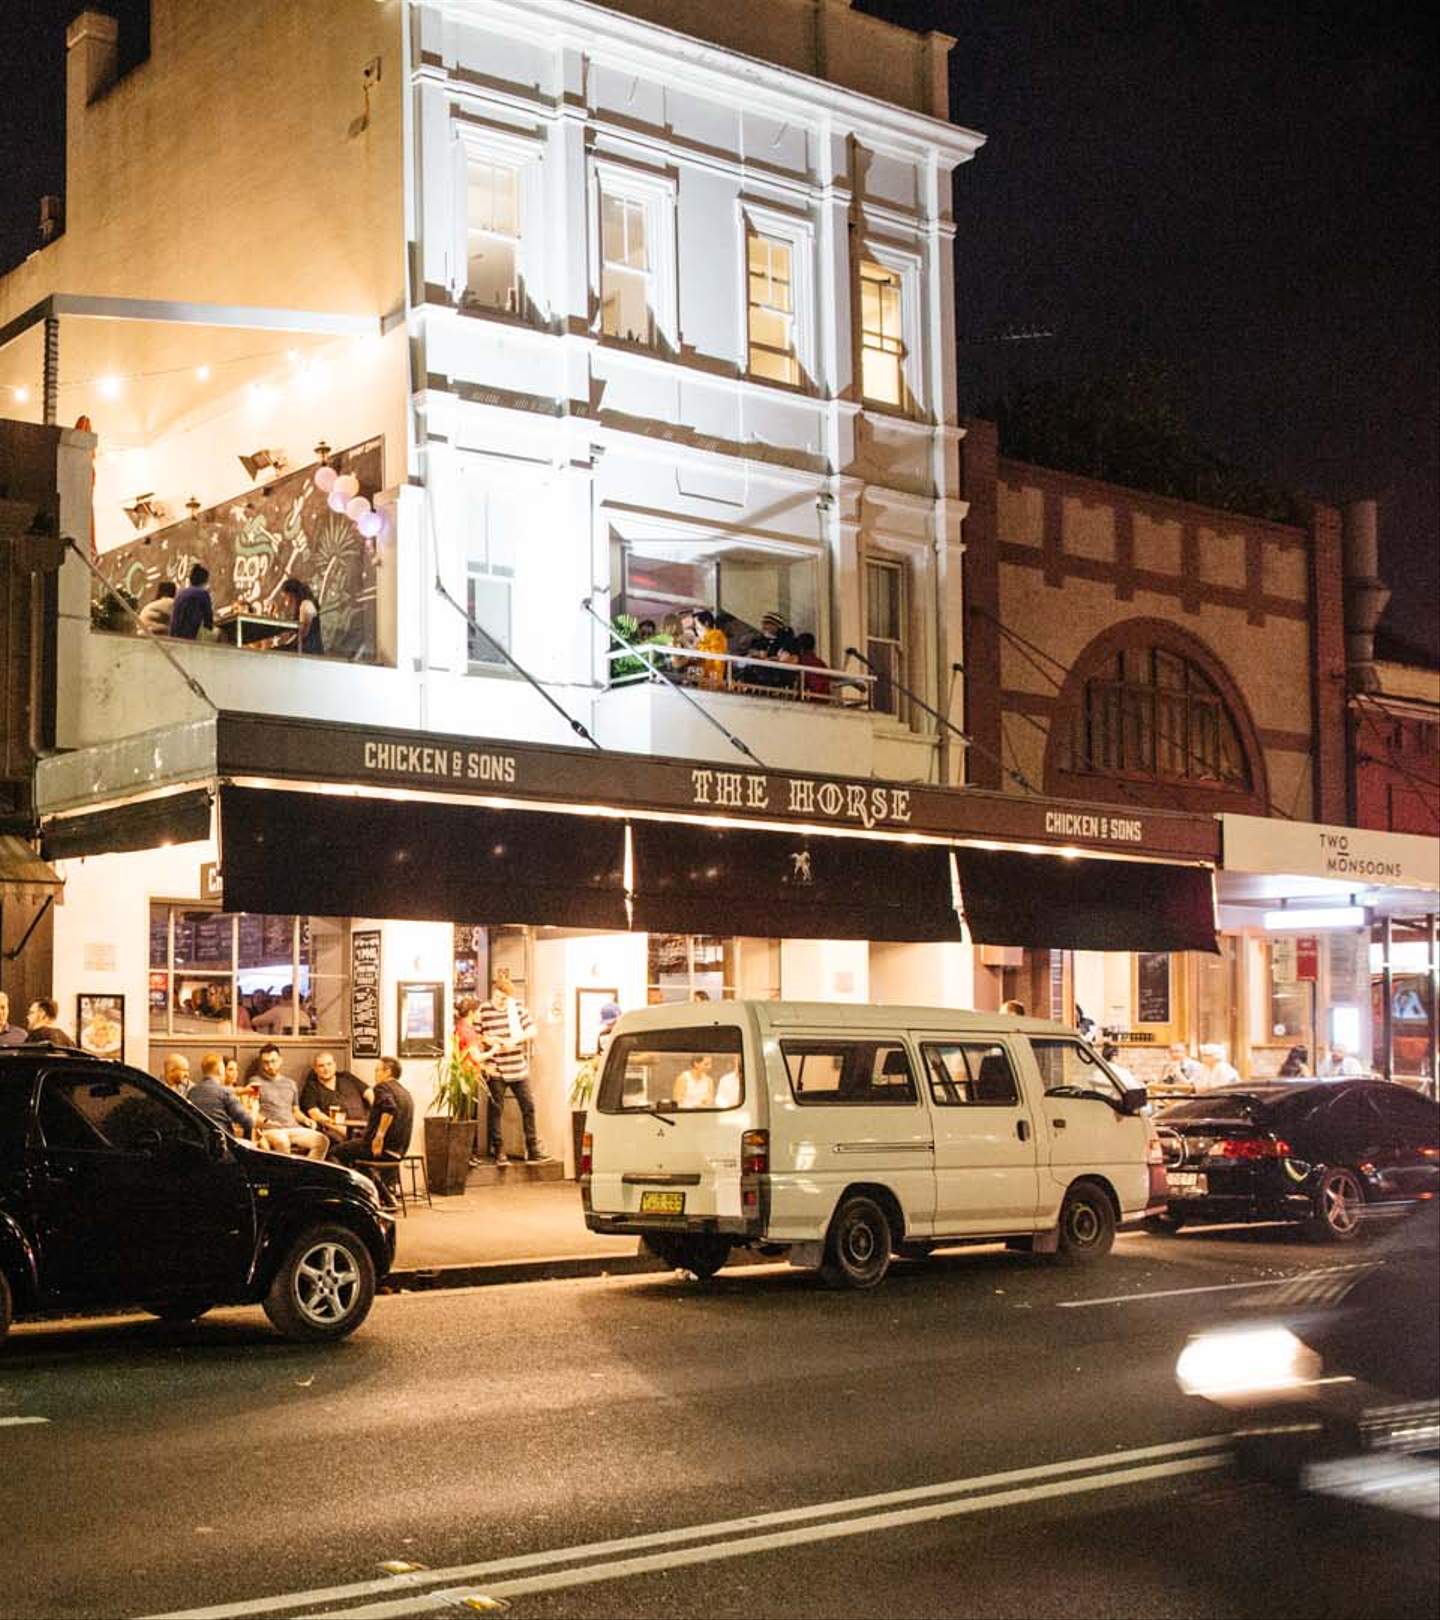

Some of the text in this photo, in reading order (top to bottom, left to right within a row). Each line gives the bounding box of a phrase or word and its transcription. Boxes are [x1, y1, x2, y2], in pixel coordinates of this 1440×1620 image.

[364, 742, 516, 783] CHICKEN & SONS
[691, 769, 912, 828] THE HORSE
[1045, 812, 1142, 841] CHICKEN & SONS
[1319, 834, 1349, 851] TWO
[1327, 858, 1402, 877] MONSOONS
